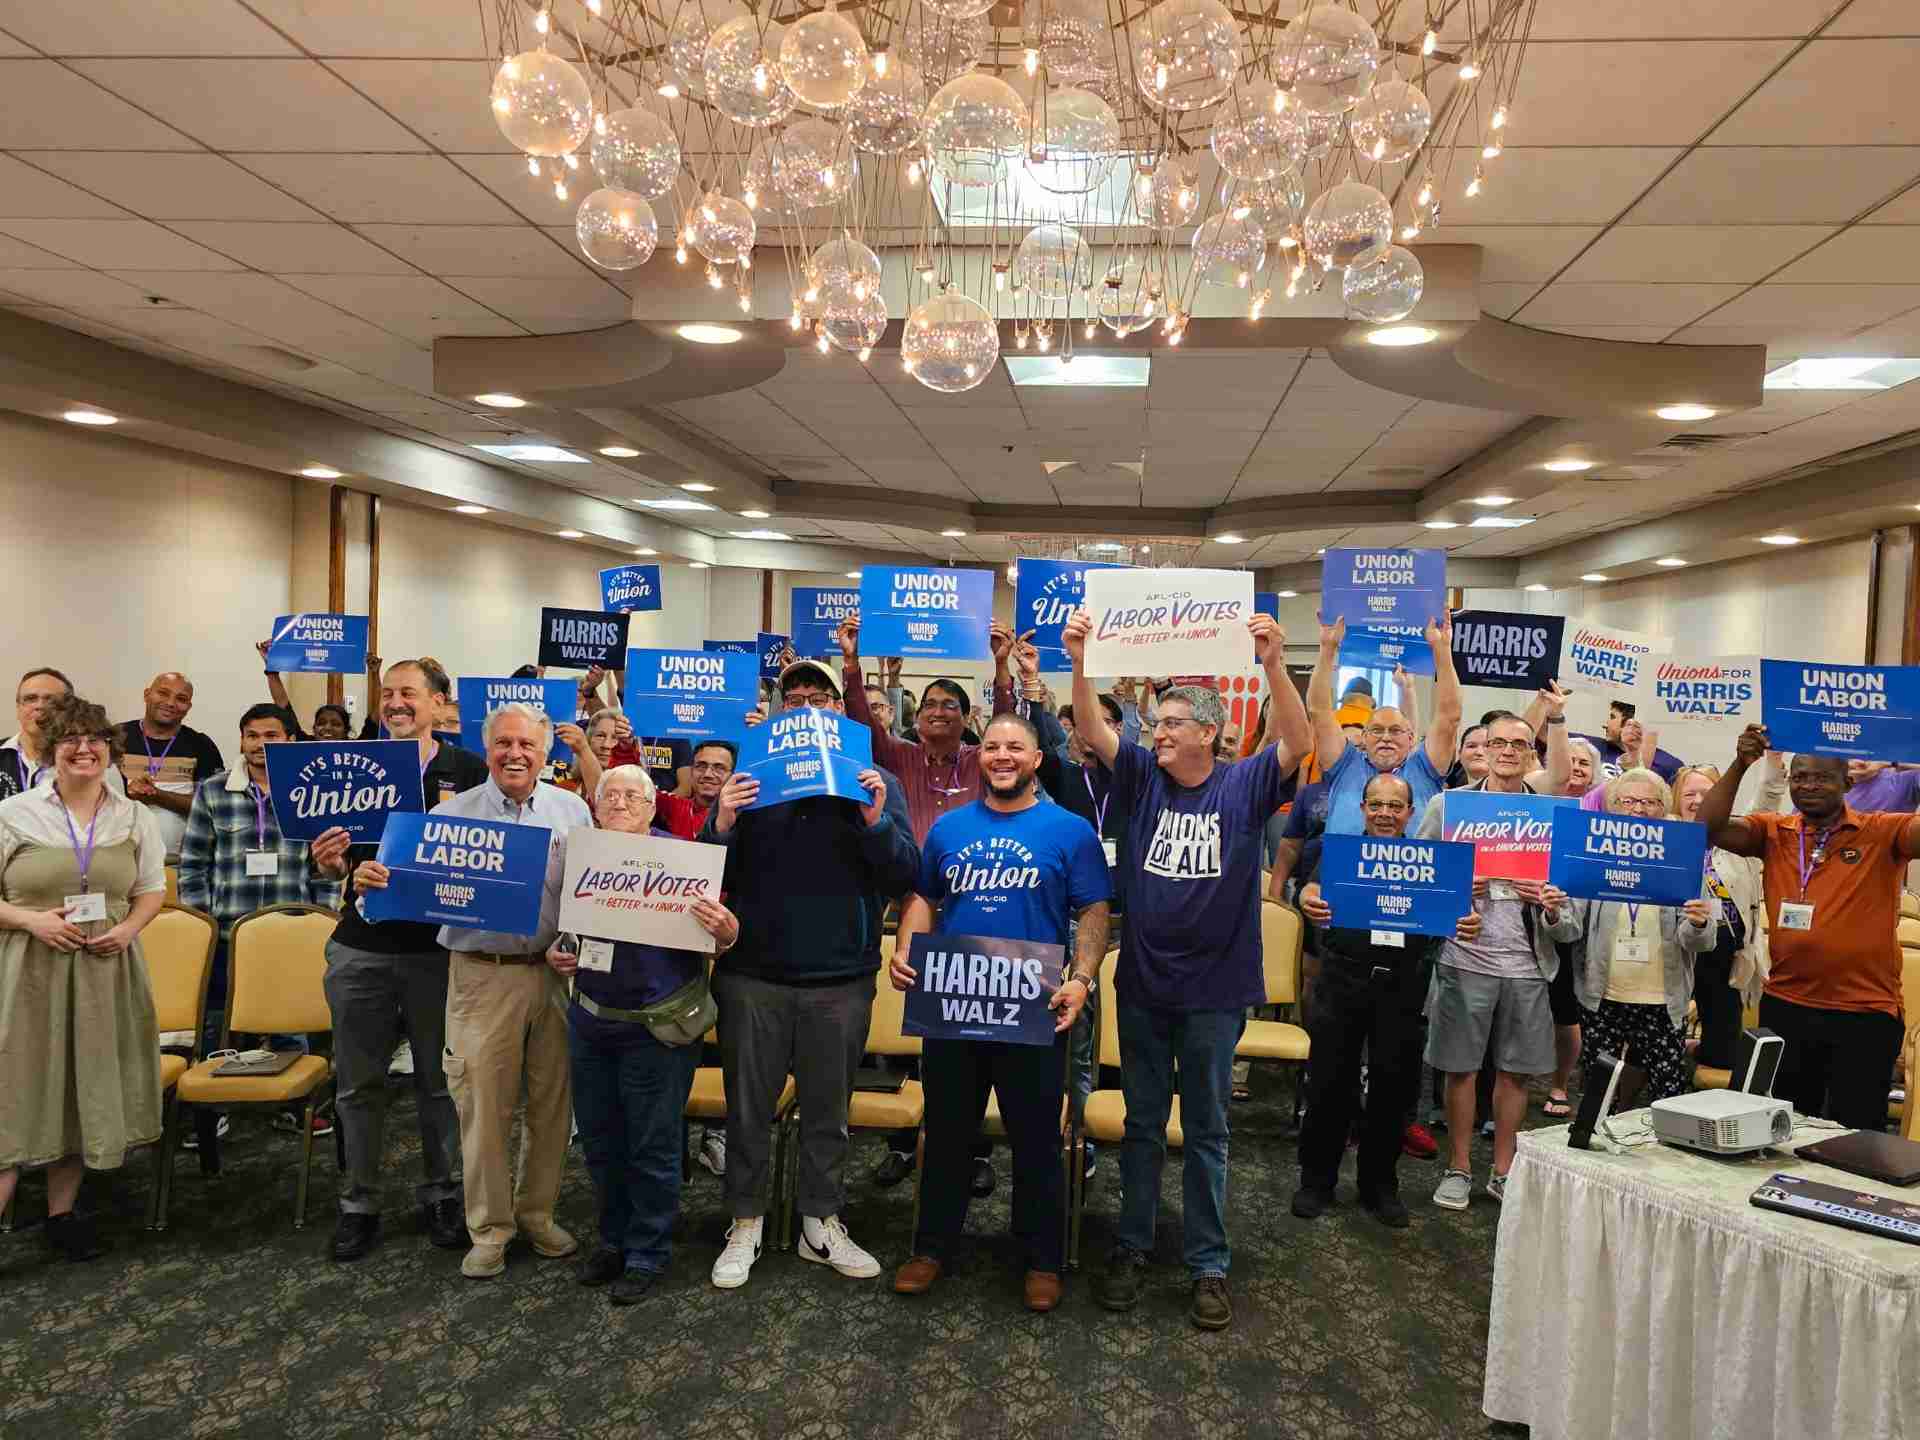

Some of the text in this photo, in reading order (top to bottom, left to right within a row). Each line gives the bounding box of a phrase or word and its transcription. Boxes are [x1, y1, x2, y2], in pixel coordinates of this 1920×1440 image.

[1355, 554, 1414, 569] UNION
[894, 573, 958, 591] UNION
[1043, 572, 1068, 594] IT'S
[1352, 570, 1415, 584] LABOR
[608, 584, 652, 604] Union
[891, 592, 959, 610] LABOR
[1146, 592, 1191, 600] AFL-CIO
[815, 606, 860, 619] LABO
[1097, 600, 1240, 640] LABOR VOTES
[296, 618, 342, 630] UNION
[551, 618, 618, 646] HARRIS
[908, 622, 938, 636] HARRIS
[293, 629, 344, 641] LABOR
[1133, 632, 1170, 644] BETTER
[1186, 628, 1220, 640] UNION
[1452, 622, 1548, 658] HARRIS
[1574, 629, 1624, 652] Unions
[560, 645, 607, 660] WALZ
[661, 656, 724, 674] UNION
[1466, 656, 1530, 677] WALZ
[1576, 661, 1635, 686] WALZ
[1656, 662, 1751, 680] Unions FOR
[656, 672, 726, 692] LABOR
[1656, 680, 1752, 700] HARRIS
[1802, 669, 1884, 691] UNION
[487, 684, 544, 700] UNION
[1800, 688, 1887, 710] LABOR
[486, 701, 545, 714] LAR
[673, 704, 704, 717] HARRIS
[1665, 700, 1741, 716] WALZ
[772, 714, 839, 736] UNION
[1822, 722, 1862, 736] HARRIS
[768, 732, 842, 754] LABOR
[1828, 734, 1856, 742] WALZ
[299, 752, 386, 782] IT'S BETTER
[332, 771, 353, 780] IN A
[290, 782, 402, 818] Union
[1157, 808, 1220, 841] NIONS
[1452, 818, 1552, 842] LABOR VOT
[1590, 818, 1664, 842] UNION
[424, 822, 506, 850] UNION
[415, 843, 504, 872] LABOR
[958, 838, 1033, 862] IT'S BETTER
[1150, 840, 1219, 874] OR ALL
[1362, 843, 1434, 864] UNION
[1585, 836, 1664, 860] LABOR
[621, 860, 664, 869] AFL-CIO
[1357, 862, 1435, 884] LABOR
[450, 872, 464, 880] FOR
[574, 867, 709, 898] LABOR VOTES
[946, 862, 1042, 894] Union
[1605, 868, 1641, 883] HARRIS
[1610, 880, 1635, 888] WALZ
[435, 883, 475, 900] HARRIS
[1376, 895, 1412, 908] HARRIS
[440, 897, 468, 908] WALZ
[607, 897, 640, 910] BETTER
[656, 902, 686, 912] UNION
[1382, 907, 1408, 916] WALZ
[924, 952, 1042, 1000] HARRIS
[941, 998, 1020, 1026] WALZ
